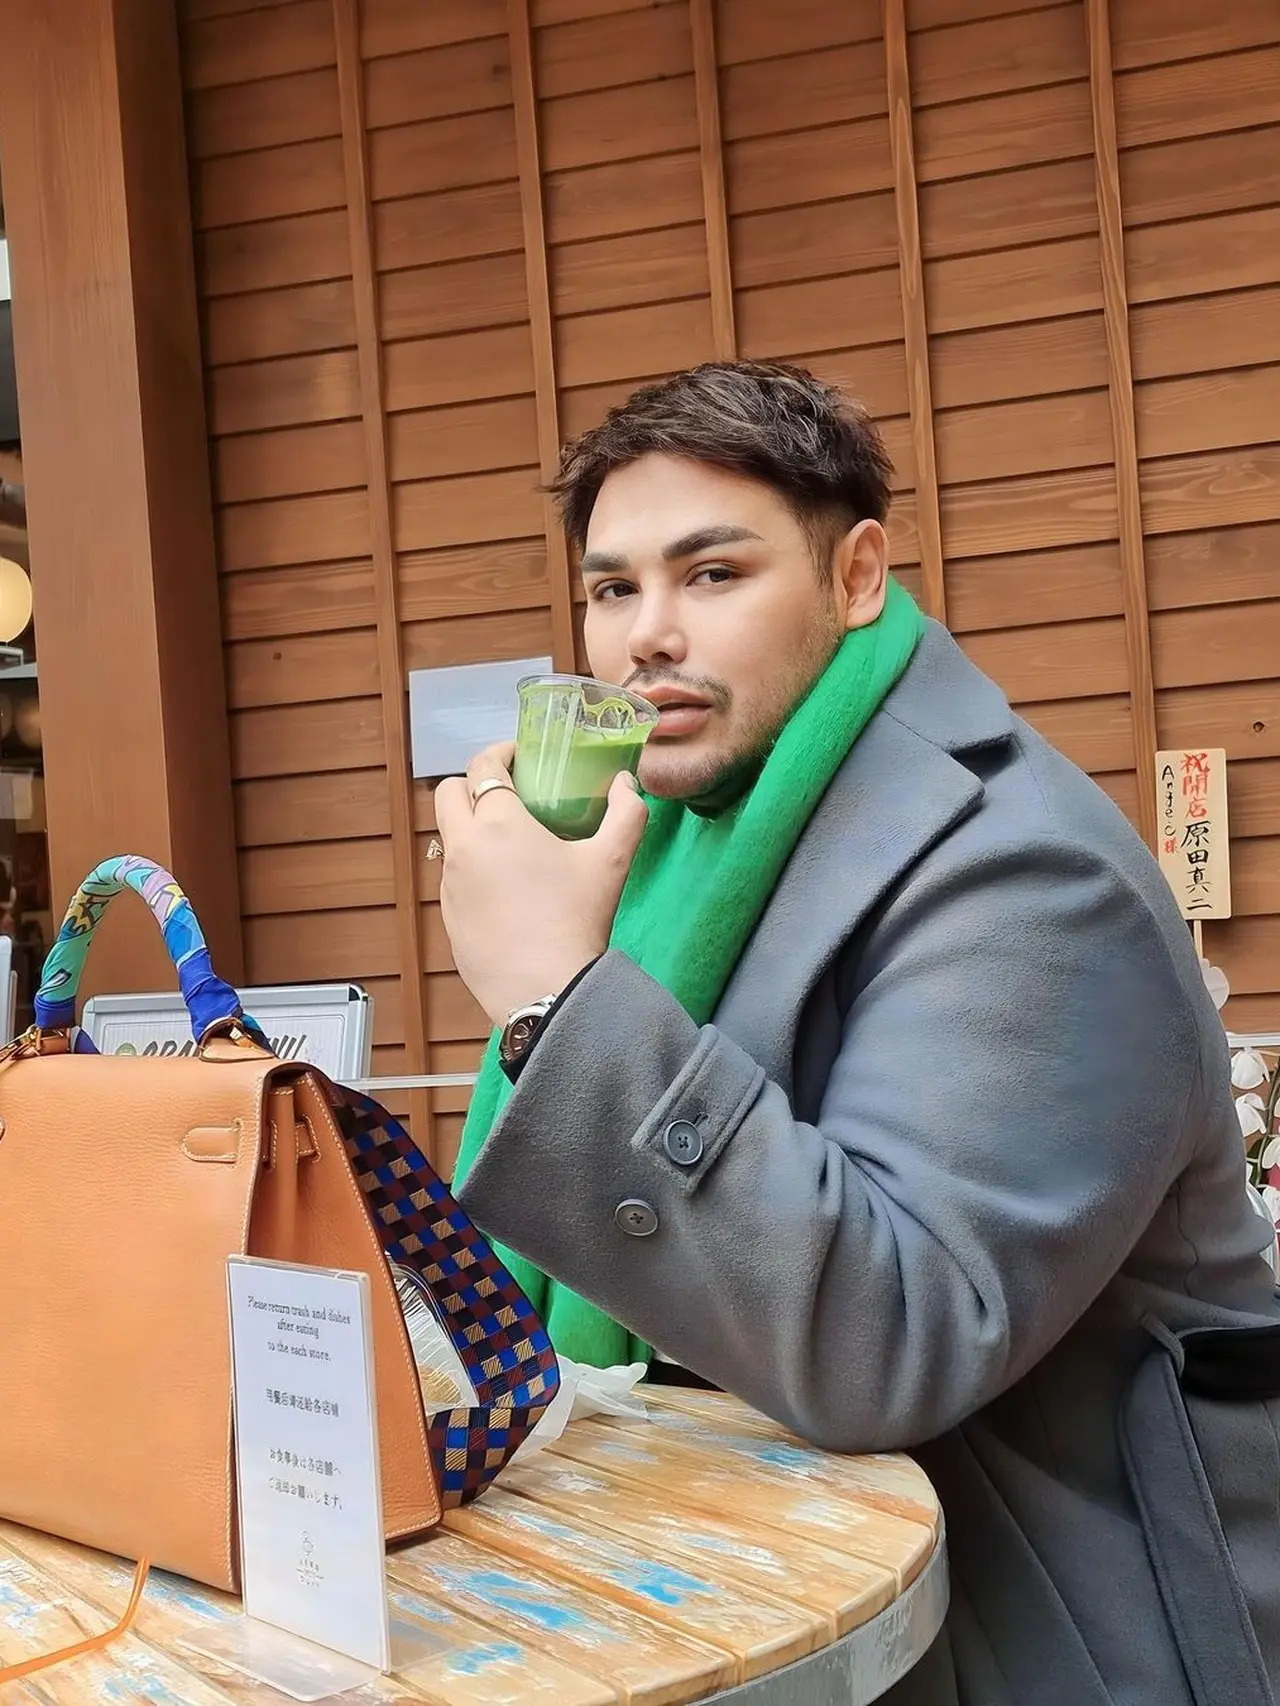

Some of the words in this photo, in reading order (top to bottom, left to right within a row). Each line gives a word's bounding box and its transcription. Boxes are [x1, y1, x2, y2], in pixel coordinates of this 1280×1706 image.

[1180, 820, 1213, 910] 原田真二
[268, 1303, 290, 1315] return
[291, 1304, 310, 1317] trash
[312, 1306, 326, 1320] and
[328, 1308, 351, 1324] dishes
[277, 1317, 294, 1332] after
[295, 1322, 319, 1340] eating
[267, 1340, 275, 1351] to
[276, 1339, 289, 1353] the
[290, 1343, 307, 1357] each
